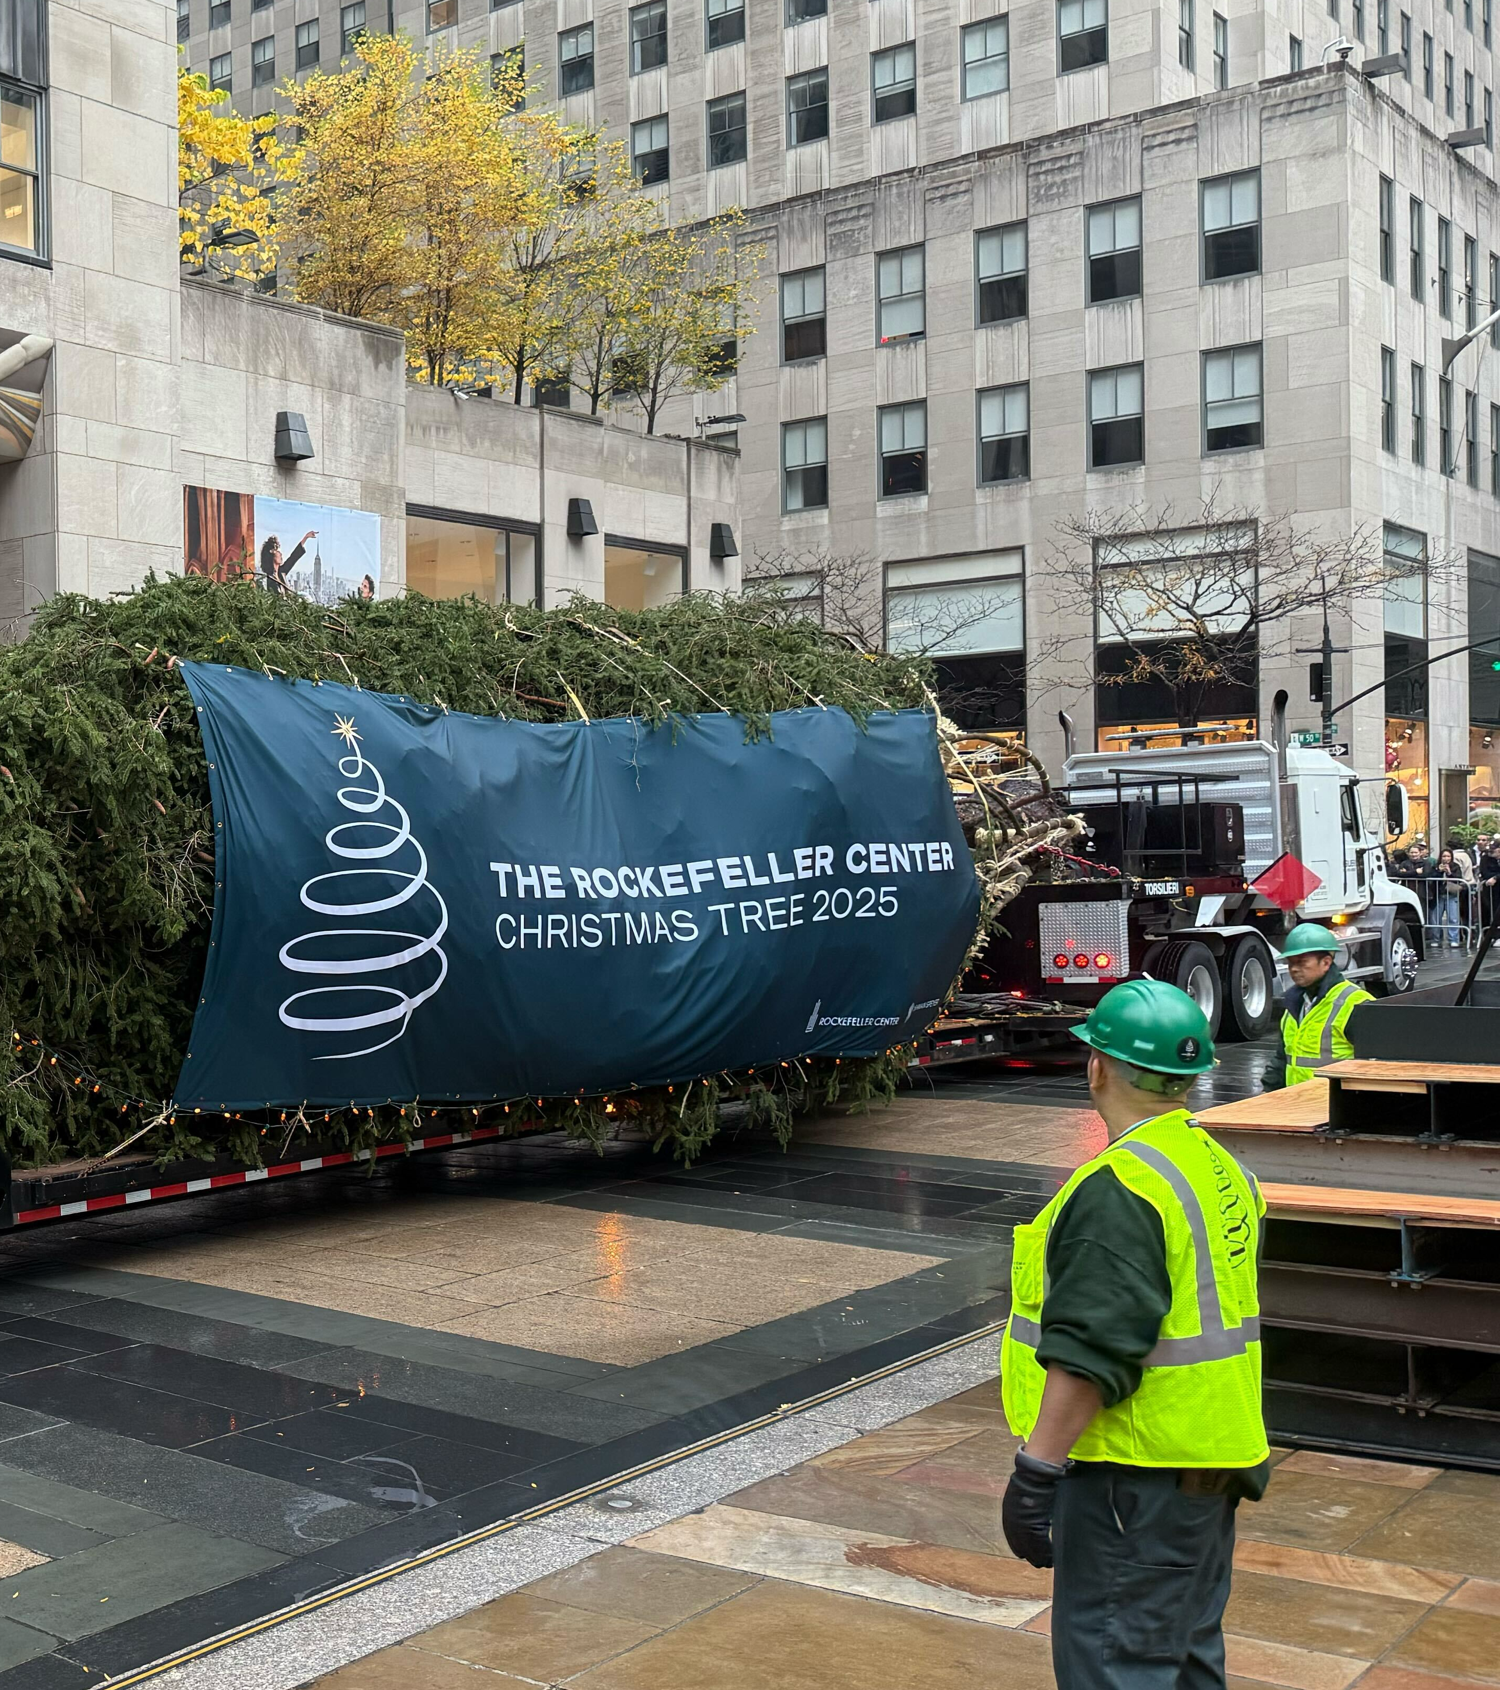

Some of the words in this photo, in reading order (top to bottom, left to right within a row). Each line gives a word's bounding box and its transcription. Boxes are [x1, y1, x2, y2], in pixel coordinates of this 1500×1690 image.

[1305, 734, 1314, 742] 50
[489, 861, 567, 899] THE
[569, 845, 835, 899] ROCKEFELLER
[845, 842, 955, 875] CENTER
[1144, 881, 1179, 896] TORSILIERI
[495, 909, 699, 949] CHRISTMAS
[707, 893, 805, 937] TREE
[812, 886, 899, 922] 2025
[818, 1016, 874, 1027] ROCKEFELLER
[874, 1016, 900, 1026] CENTER
